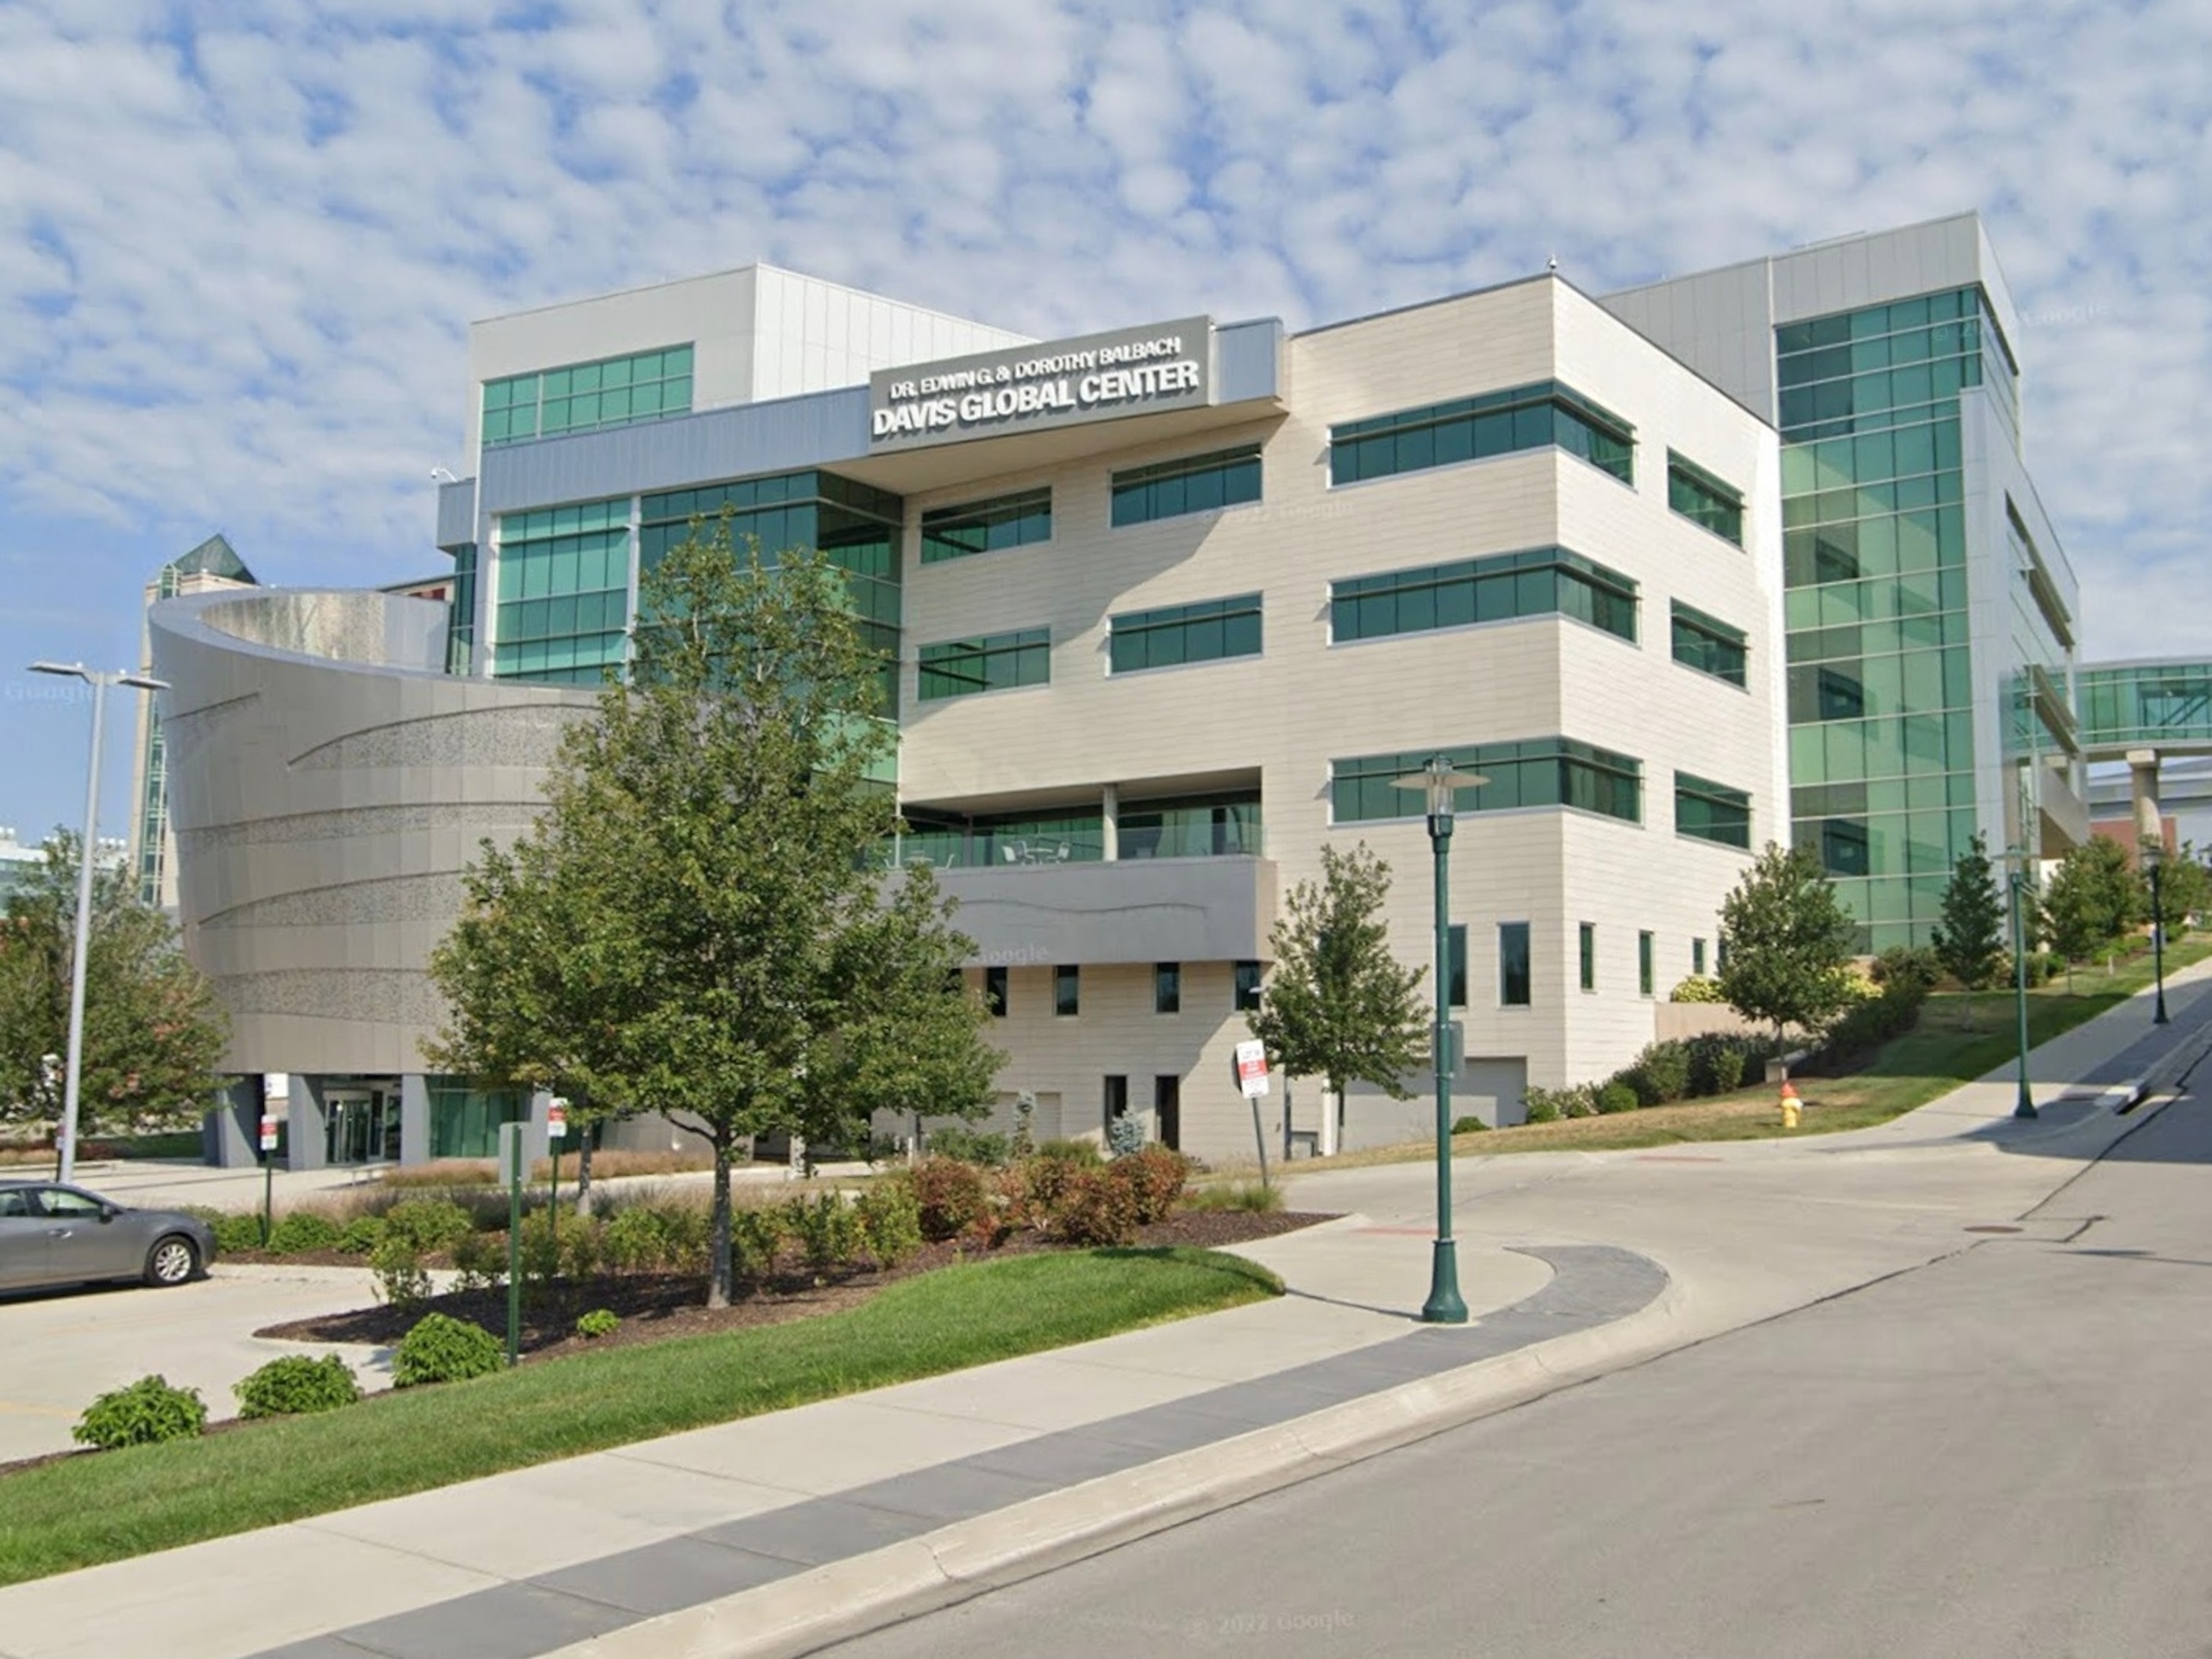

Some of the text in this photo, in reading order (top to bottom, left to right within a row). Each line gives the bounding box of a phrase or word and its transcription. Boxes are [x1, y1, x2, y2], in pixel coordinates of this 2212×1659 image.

[873, 360, 1200, 435] DAVIS GLOBAL CENTER
[890, 336, 1182, 399] DR. EDWIN G. & DOROTHY BALBACH
